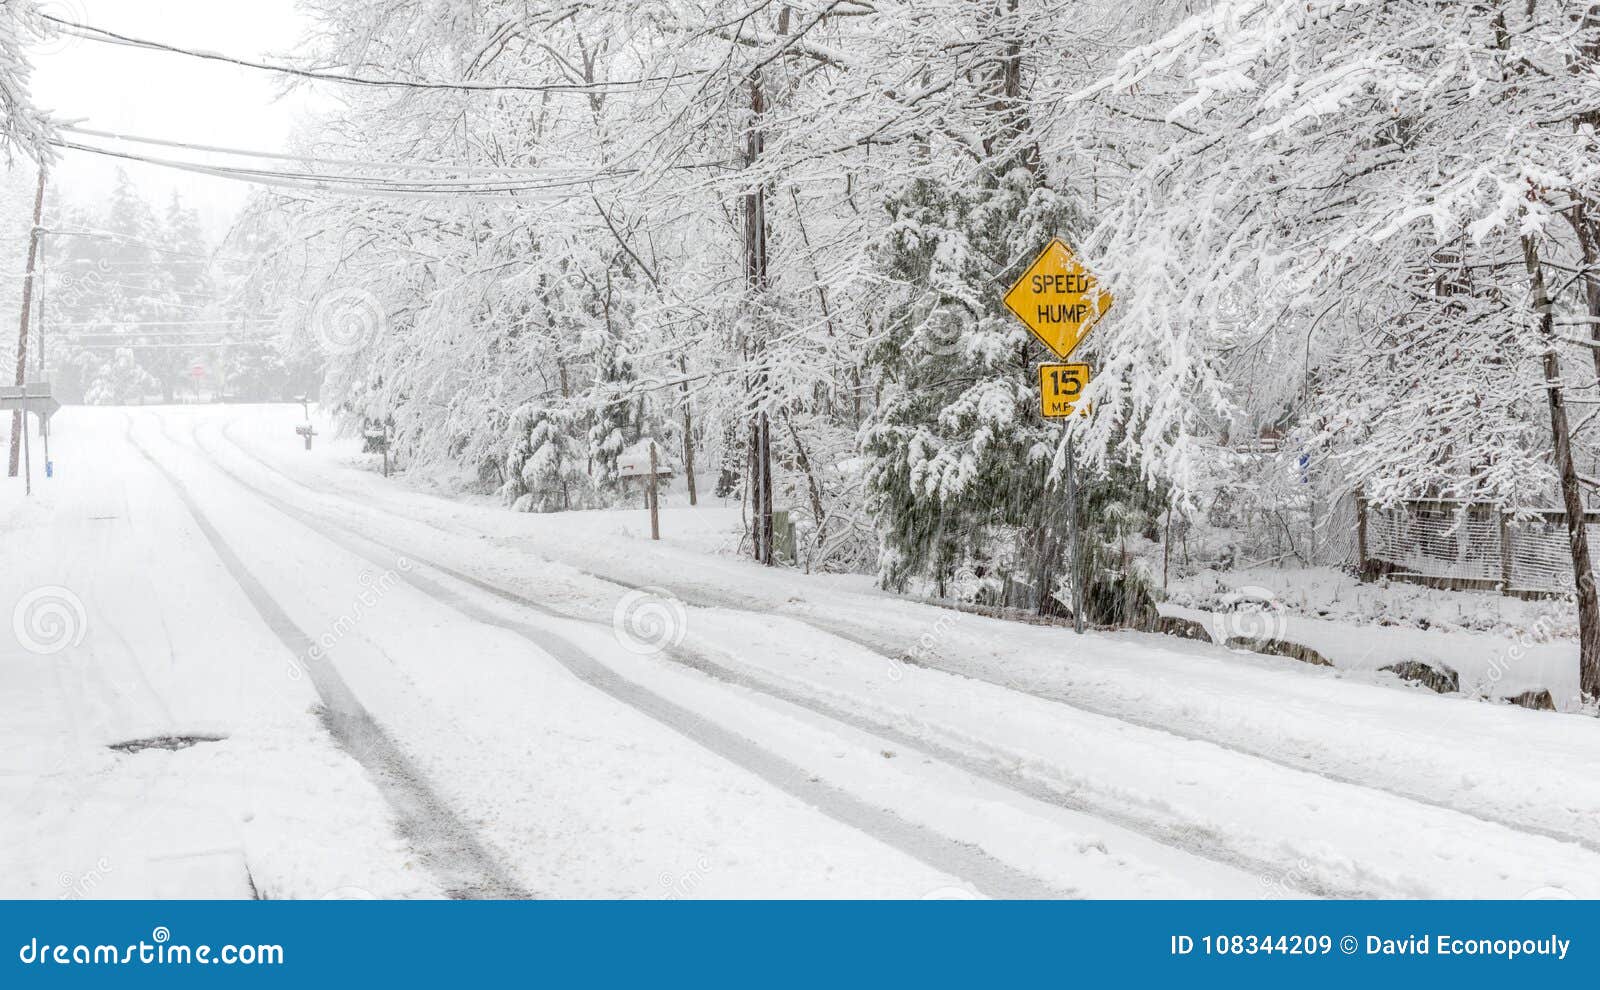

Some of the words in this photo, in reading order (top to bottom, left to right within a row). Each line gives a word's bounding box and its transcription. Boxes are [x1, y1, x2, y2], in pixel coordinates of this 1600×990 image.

[1032, 274, 1088, 294] SPEED
[1038, 304, 1086, 324] HUMP
[1050, 370, 1082, 396] 15
